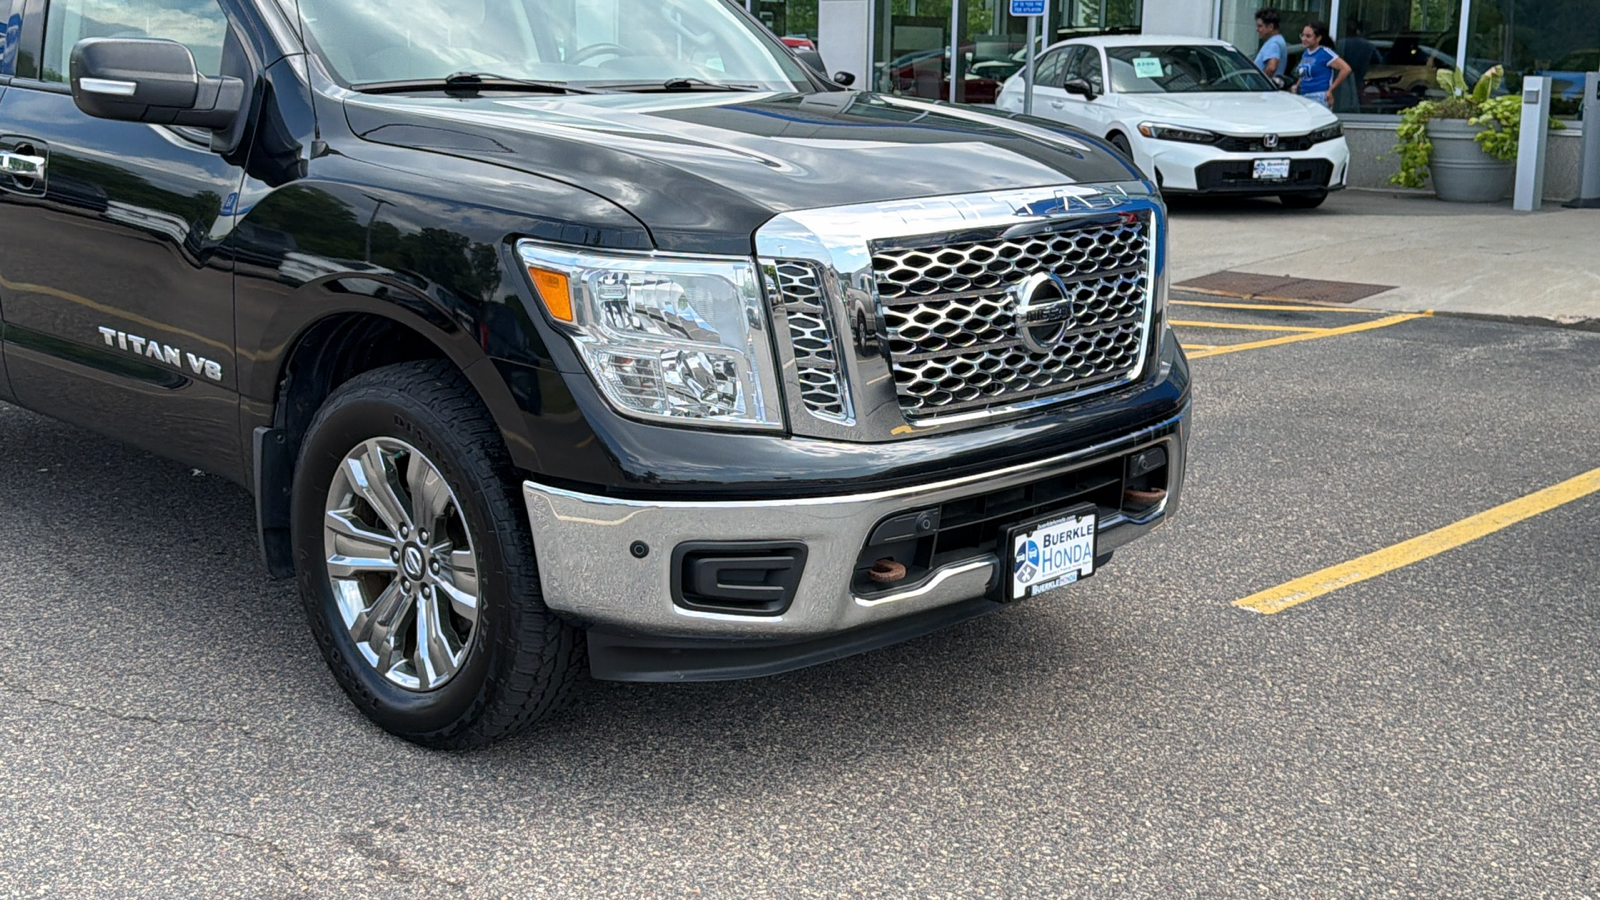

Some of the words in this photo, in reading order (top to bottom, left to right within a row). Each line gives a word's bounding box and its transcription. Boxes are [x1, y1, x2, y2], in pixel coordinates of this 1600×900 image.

[98, 326, 181, 368] TITAN
[186, 352, 222, 381] V8
[1043, 524, 1094, 549] BUERKLE
[1042, 541, 1092, 573] HONDA
